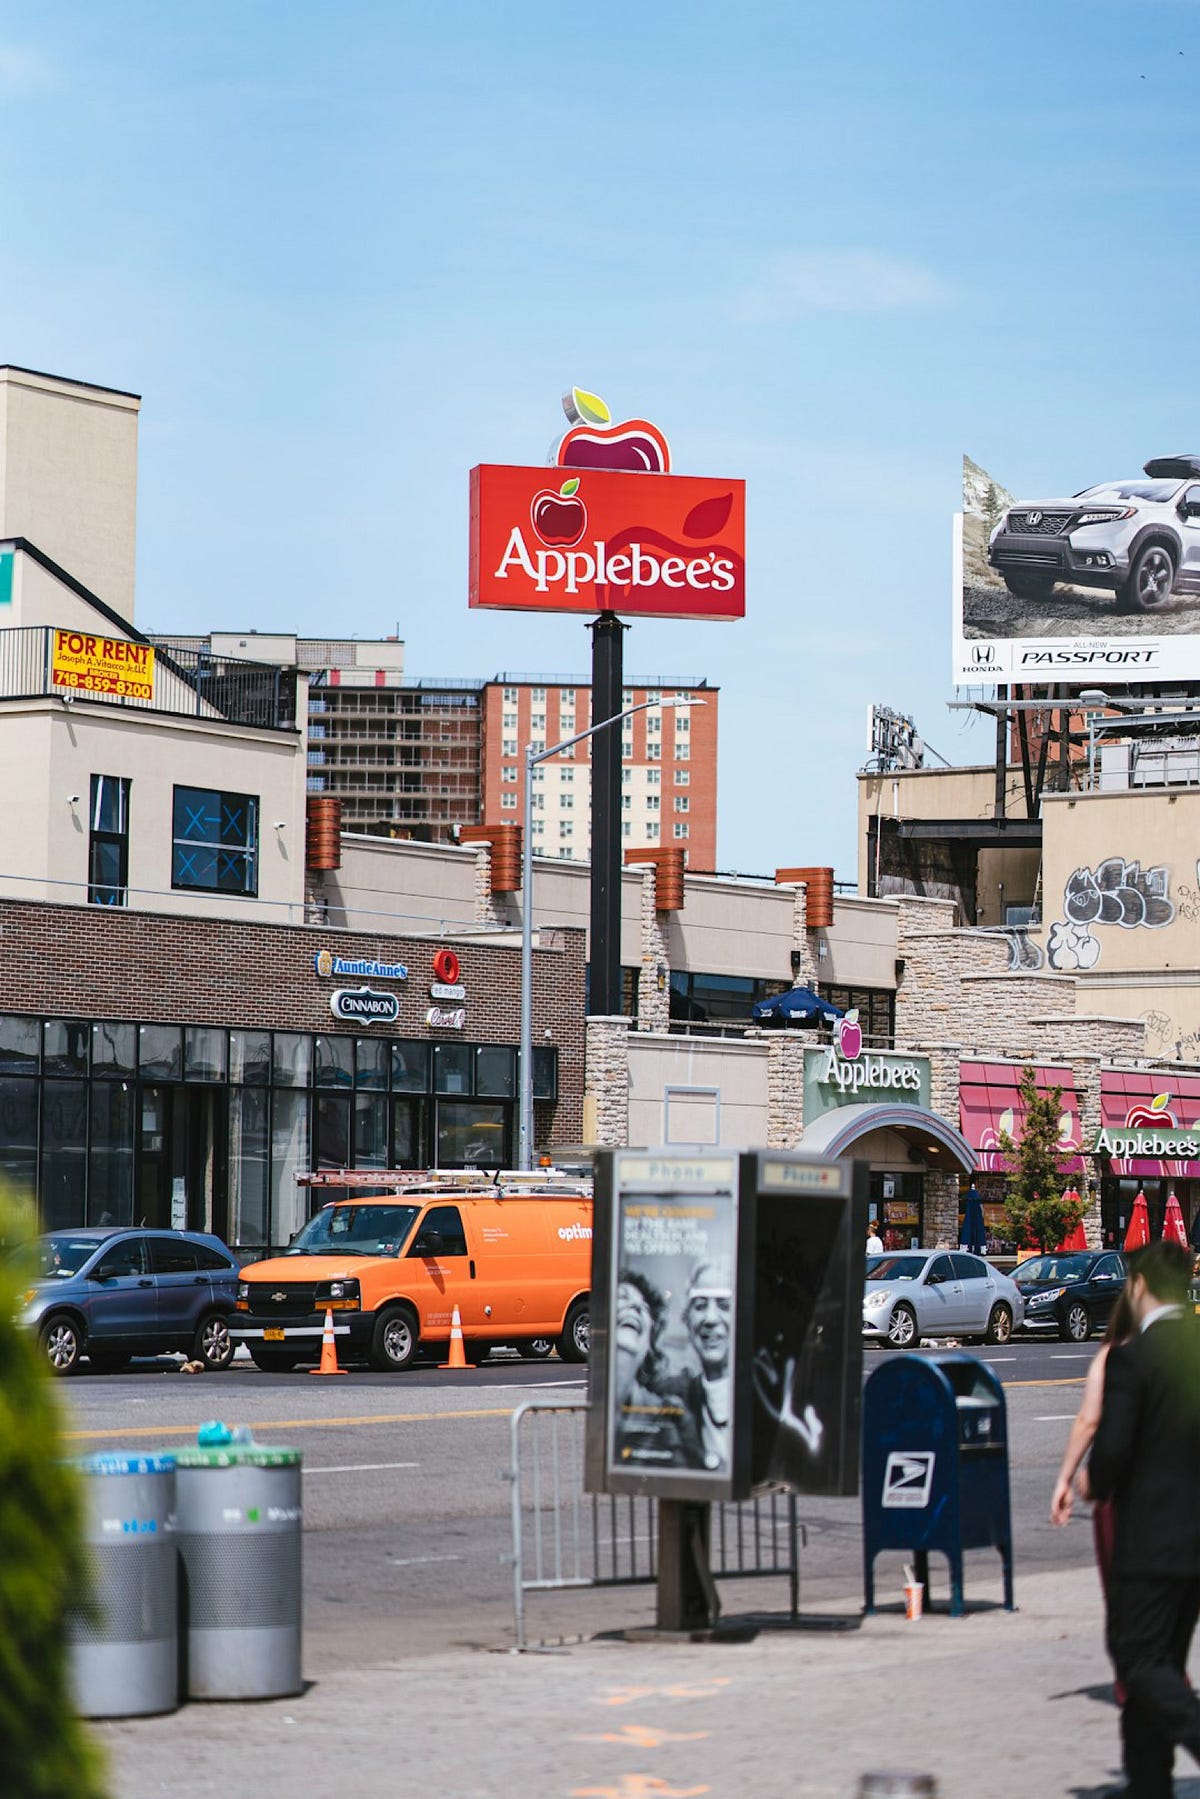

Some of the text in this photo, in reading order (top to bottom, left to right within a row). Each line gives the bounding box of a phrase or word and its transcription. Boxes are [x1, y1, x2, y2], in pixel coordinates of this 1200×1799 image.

[494, 526, 735, 594] Applebee's
[57, 653, 85, 665] Joseph
[58, 632, 150, 665] FOR RENT
[1021, 651, 1159, 664] PASSPORT
[56, 671, 150, 697] 718-859-8200
[341, 997, 394, 1014] CINNABON
[822, 1047, 921, 1093] Applebee's
[1090, 1128, 1198, 1159] Applebee's
[649, 1158, 704, 1179] Phone
